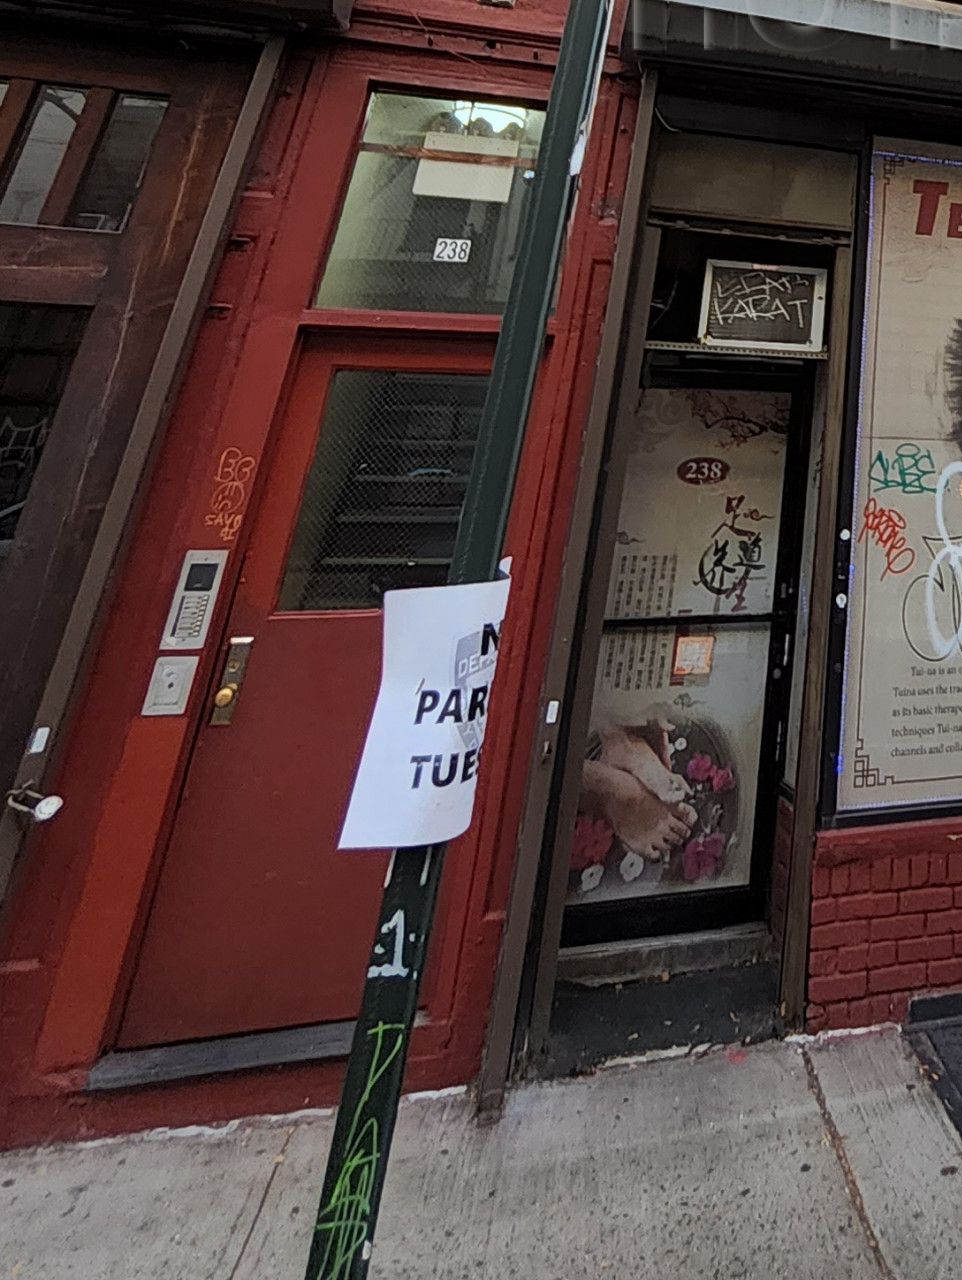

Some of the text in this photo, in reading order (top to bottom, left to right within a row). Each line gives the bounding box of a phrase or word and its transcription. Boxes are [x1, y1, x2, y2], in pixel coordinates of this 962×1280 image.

[436, 241, 469, 260] 238
[686, 462, 722, 479] 238
[939, 666, 945, 675] is
[947, 667, 956, 675] an
[917, 687, 934, 696] uses
[935, 684, 947, 694] the
[892, 708, 900, 717] as
[902, 706, 912, 716] its
[913, 703, 933, 715] basic
[891, 726, 935, 740] techniques
[890, 743, 926, 757] channels
[928, 743, 944, 754] and
